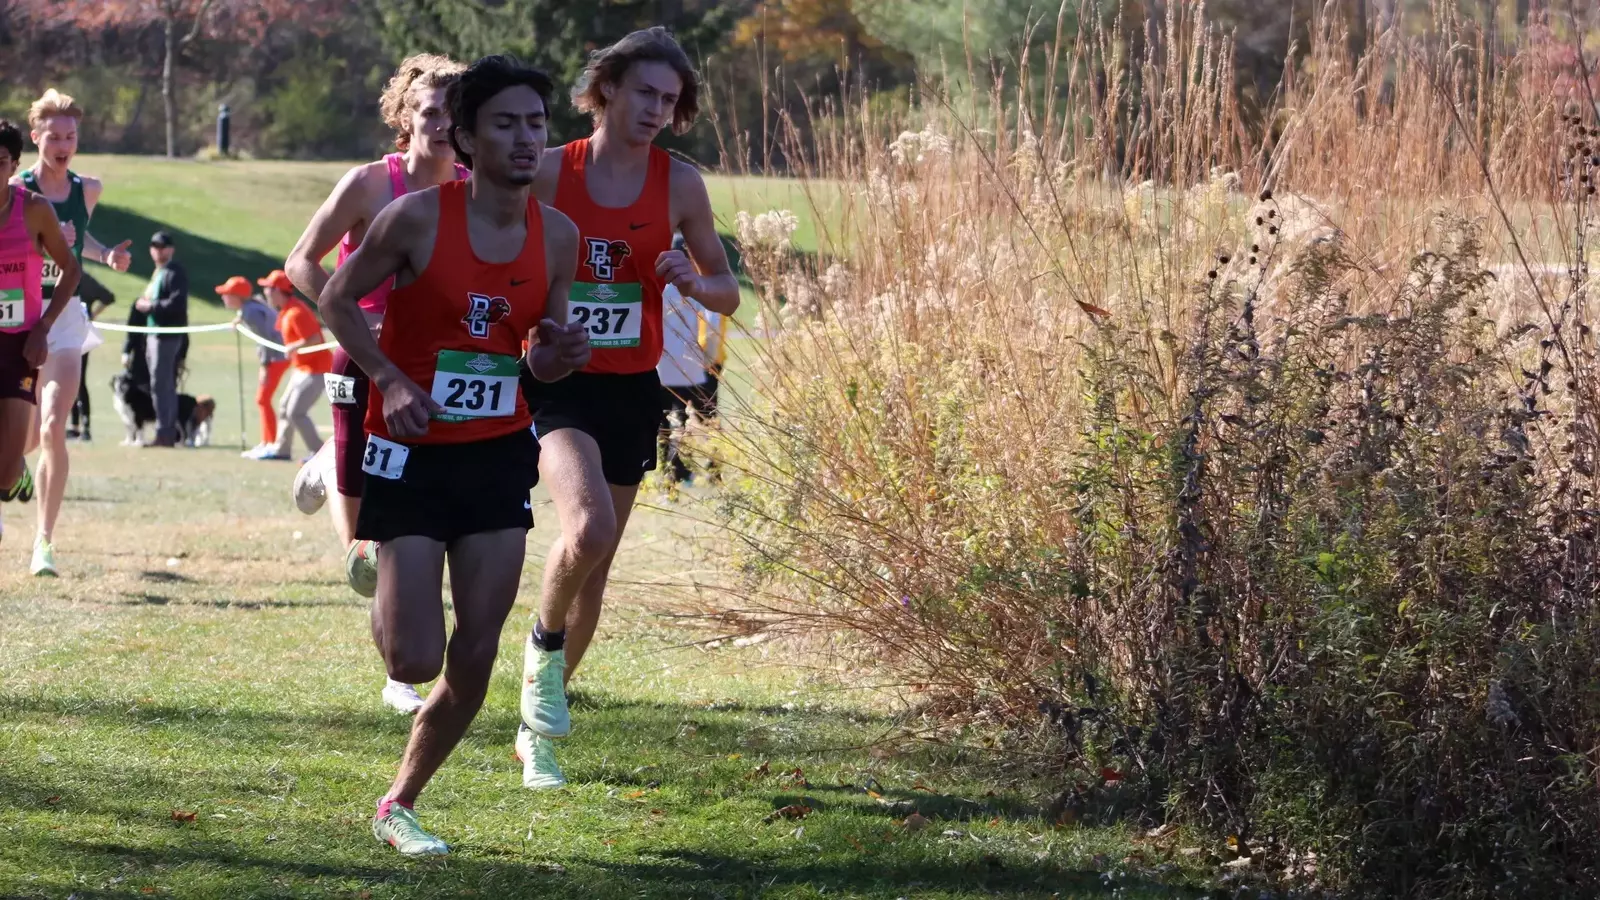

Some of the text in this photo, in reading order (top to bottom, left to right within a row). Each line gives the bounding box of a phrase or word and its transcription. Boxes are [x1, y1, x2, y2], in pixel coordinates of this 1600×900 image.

[572, 306, 630, 335] 237
[444, 378, 502, 410] 231
[364, 441, 392, 471] 31
